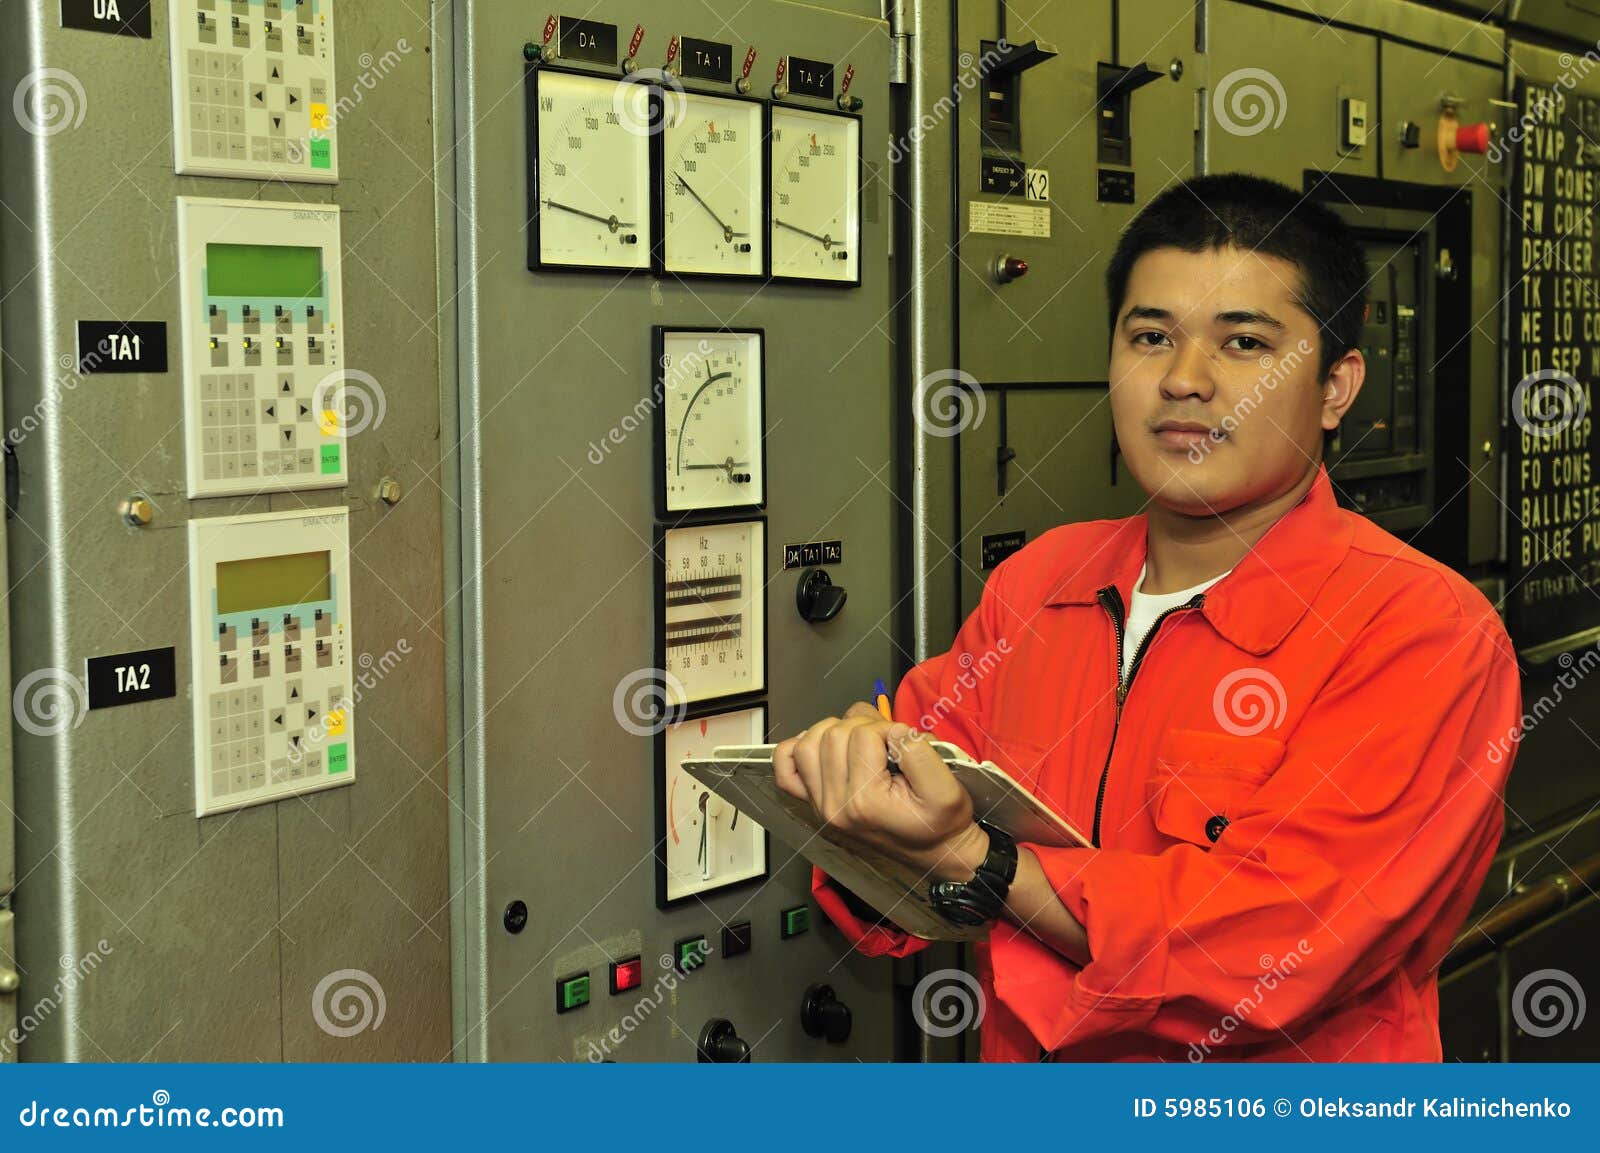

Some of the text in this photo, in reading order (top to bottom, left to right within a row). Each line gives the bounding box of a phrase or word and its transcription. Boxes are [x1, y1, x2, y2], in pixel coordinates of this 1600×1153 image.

[93, 0, 120, 21] DA
[580, 32, 596, 49] DA
[696, 51, 711, 67] TA
[800, 70, 813, 85] TA
[585, 118, 599, 130] 1500
[568, 136, 582, 149] 1000
[1523, 125, 1584, 166] EVAP 2
[554, 164, 566, 177] 500
[1555, 165, 1593, 203] CONS
[1028, 172, 1047, 200] K2
[1522, 200, 1593, 238] FW CONS
[1522, 237, 1593, 273] DEOILER
[1522, 274, 1542, 308] TK
[1521, 311, 1542, 344] ME
[1554, 311, 1573, 343] LO
[108, 334, 140, 360] TA1
[1522, 347, 1541, 381] LO
[1552, 346, 1581, 379] SEP
[1522, 452, 1591, 491] FO CONS
[699, 536, 709, 551] Hz
[804, 549, 819, 561] TA1
[1522, 526, 1572, 568] BILGE
[115, 663, 151, 693] TA2
